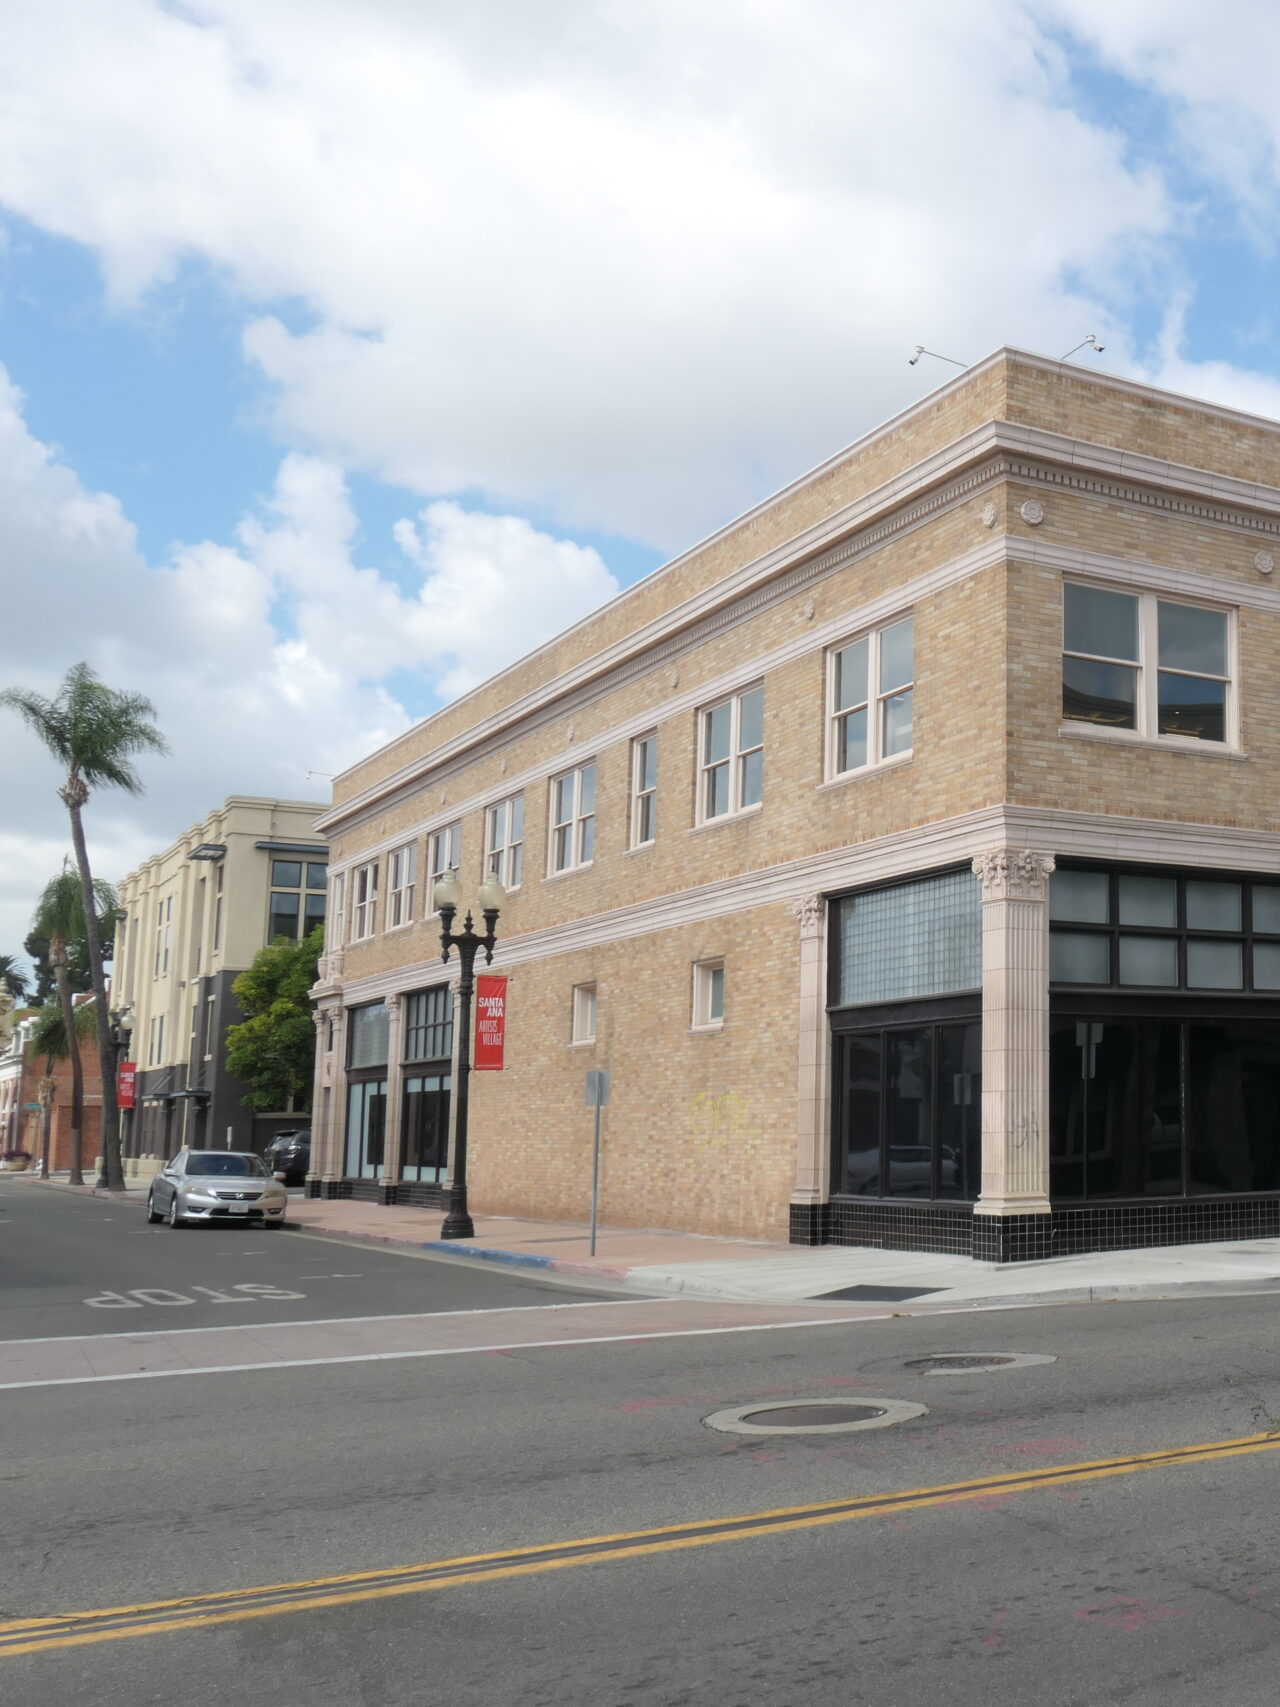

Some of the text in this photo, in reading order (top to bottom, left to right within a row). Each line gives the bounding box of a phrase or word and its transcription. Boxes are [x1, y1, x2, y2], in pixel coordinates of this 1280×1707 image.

[478, 997, 503, 1007] SANTA
[487, 1007, 503, 1017] ANA
[479, 1020, 497, 1032] ARTISTS
[482, 1033, 503, 1045] VILLAGE
[83, 1284, 307, 1308] STOP
